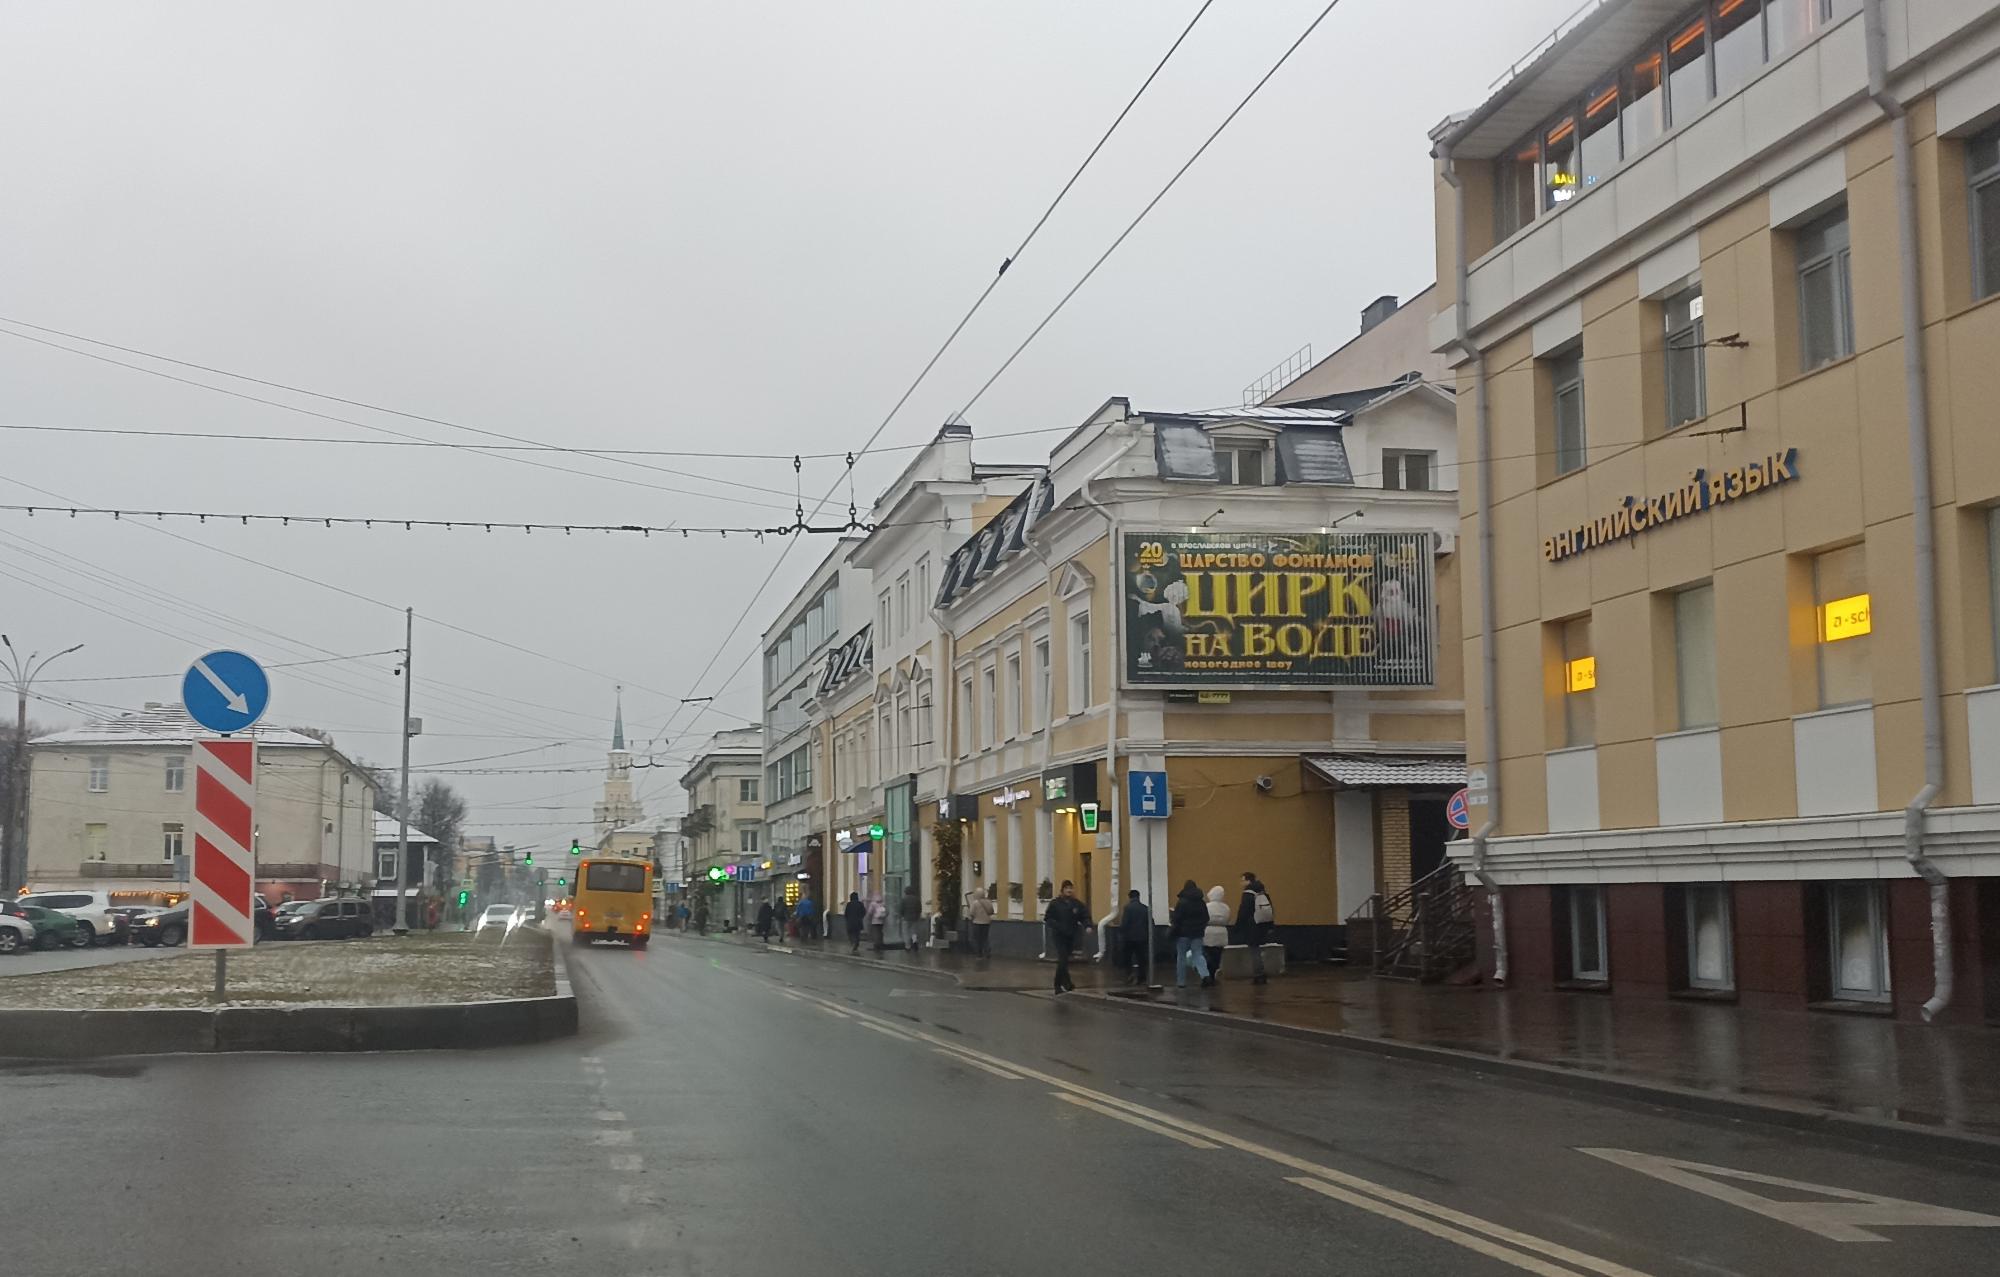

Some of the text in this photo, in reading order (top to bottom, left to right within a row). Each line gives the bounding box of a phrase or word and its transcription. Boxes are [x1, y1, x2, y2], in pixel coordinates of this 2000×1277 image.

[1140, 541, 1163, 558] 20
[1179, 553, 1265, 568] ЦАРСТВО
[1272, 554, 1374, 569] ФОНТАНОВ
[1180, 571, 1375, 624] ЦИРК
[1183, 622, 1376, 660] НА ВОДЕ
